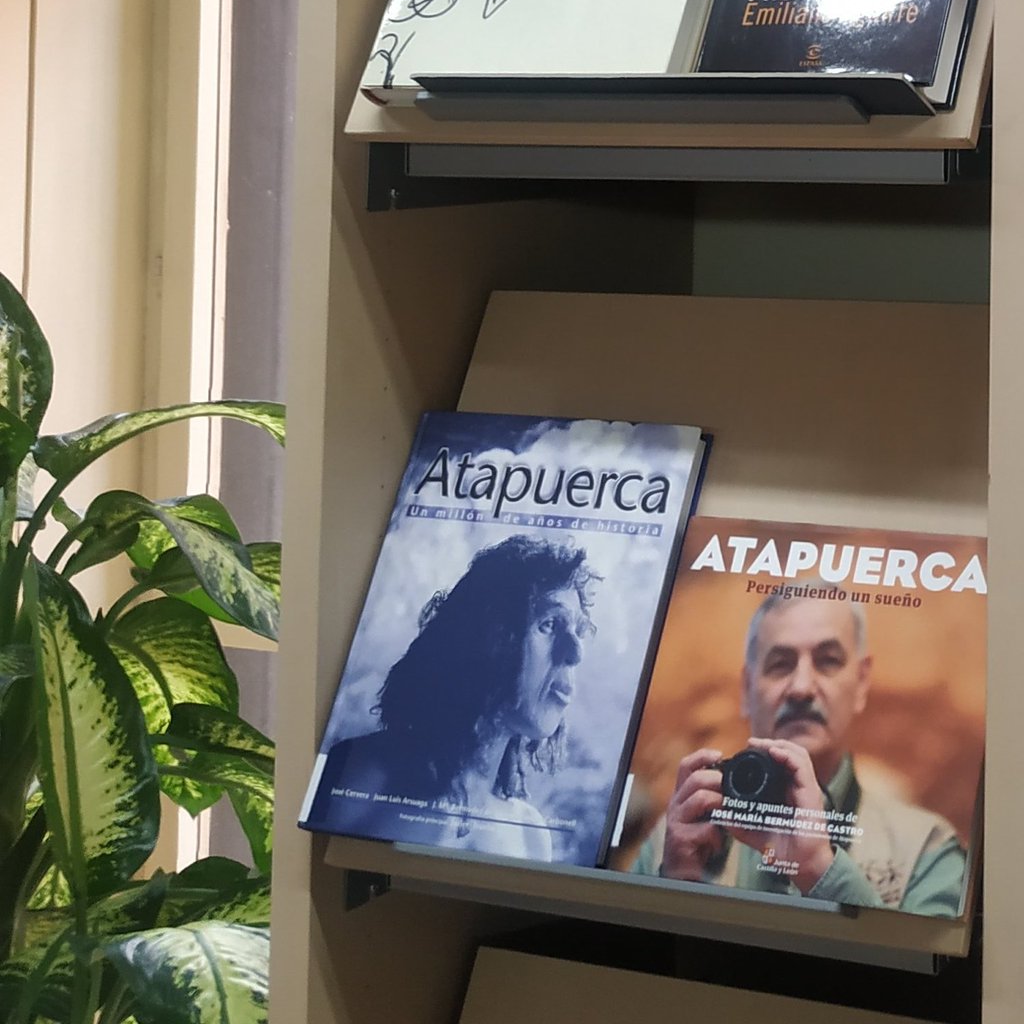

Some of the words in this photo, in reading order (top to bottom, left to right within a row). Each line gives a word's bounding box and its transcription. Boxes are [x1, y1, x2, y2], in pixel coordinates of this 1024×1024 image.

[414, 447, 672, 518] Atapuerca
[410, 506, 428, 518] Un
[435, 507, 484, 522] millón
[503, 512, 520, 524] de
[527, 514, 563, 528] años
[571, 517, 589, 529] de
[597, 520, 660, 536] historia
[690, 534, 987, 594] ATAPUERCA
[745, 580, 847, 602] Persiguiendo
[851, 591, 872, 604] un
[874, 591, 922, 608] sueño
[345, 789, 369, 799] Cervera
[373, 793, 389, 802] Juan
[389, 795, 402, 803] Luis
[402, 797, 429, 808] Arsuaga
[722, 796, 748, 810] Fotos
[749, 801, 756, 812] y
[756, 801, 793, 815] apuntes
[794, 807, 844, 822] personales
[845, 811, 858, 823] de
[711, 809, 732, 819] JOSÉ
[734, 811, 763, 824] MARÍA
[813, 822, 826, 832] DE
[826, 823, 864, 837] CASTRO
[777, 868, 783, 876] y
